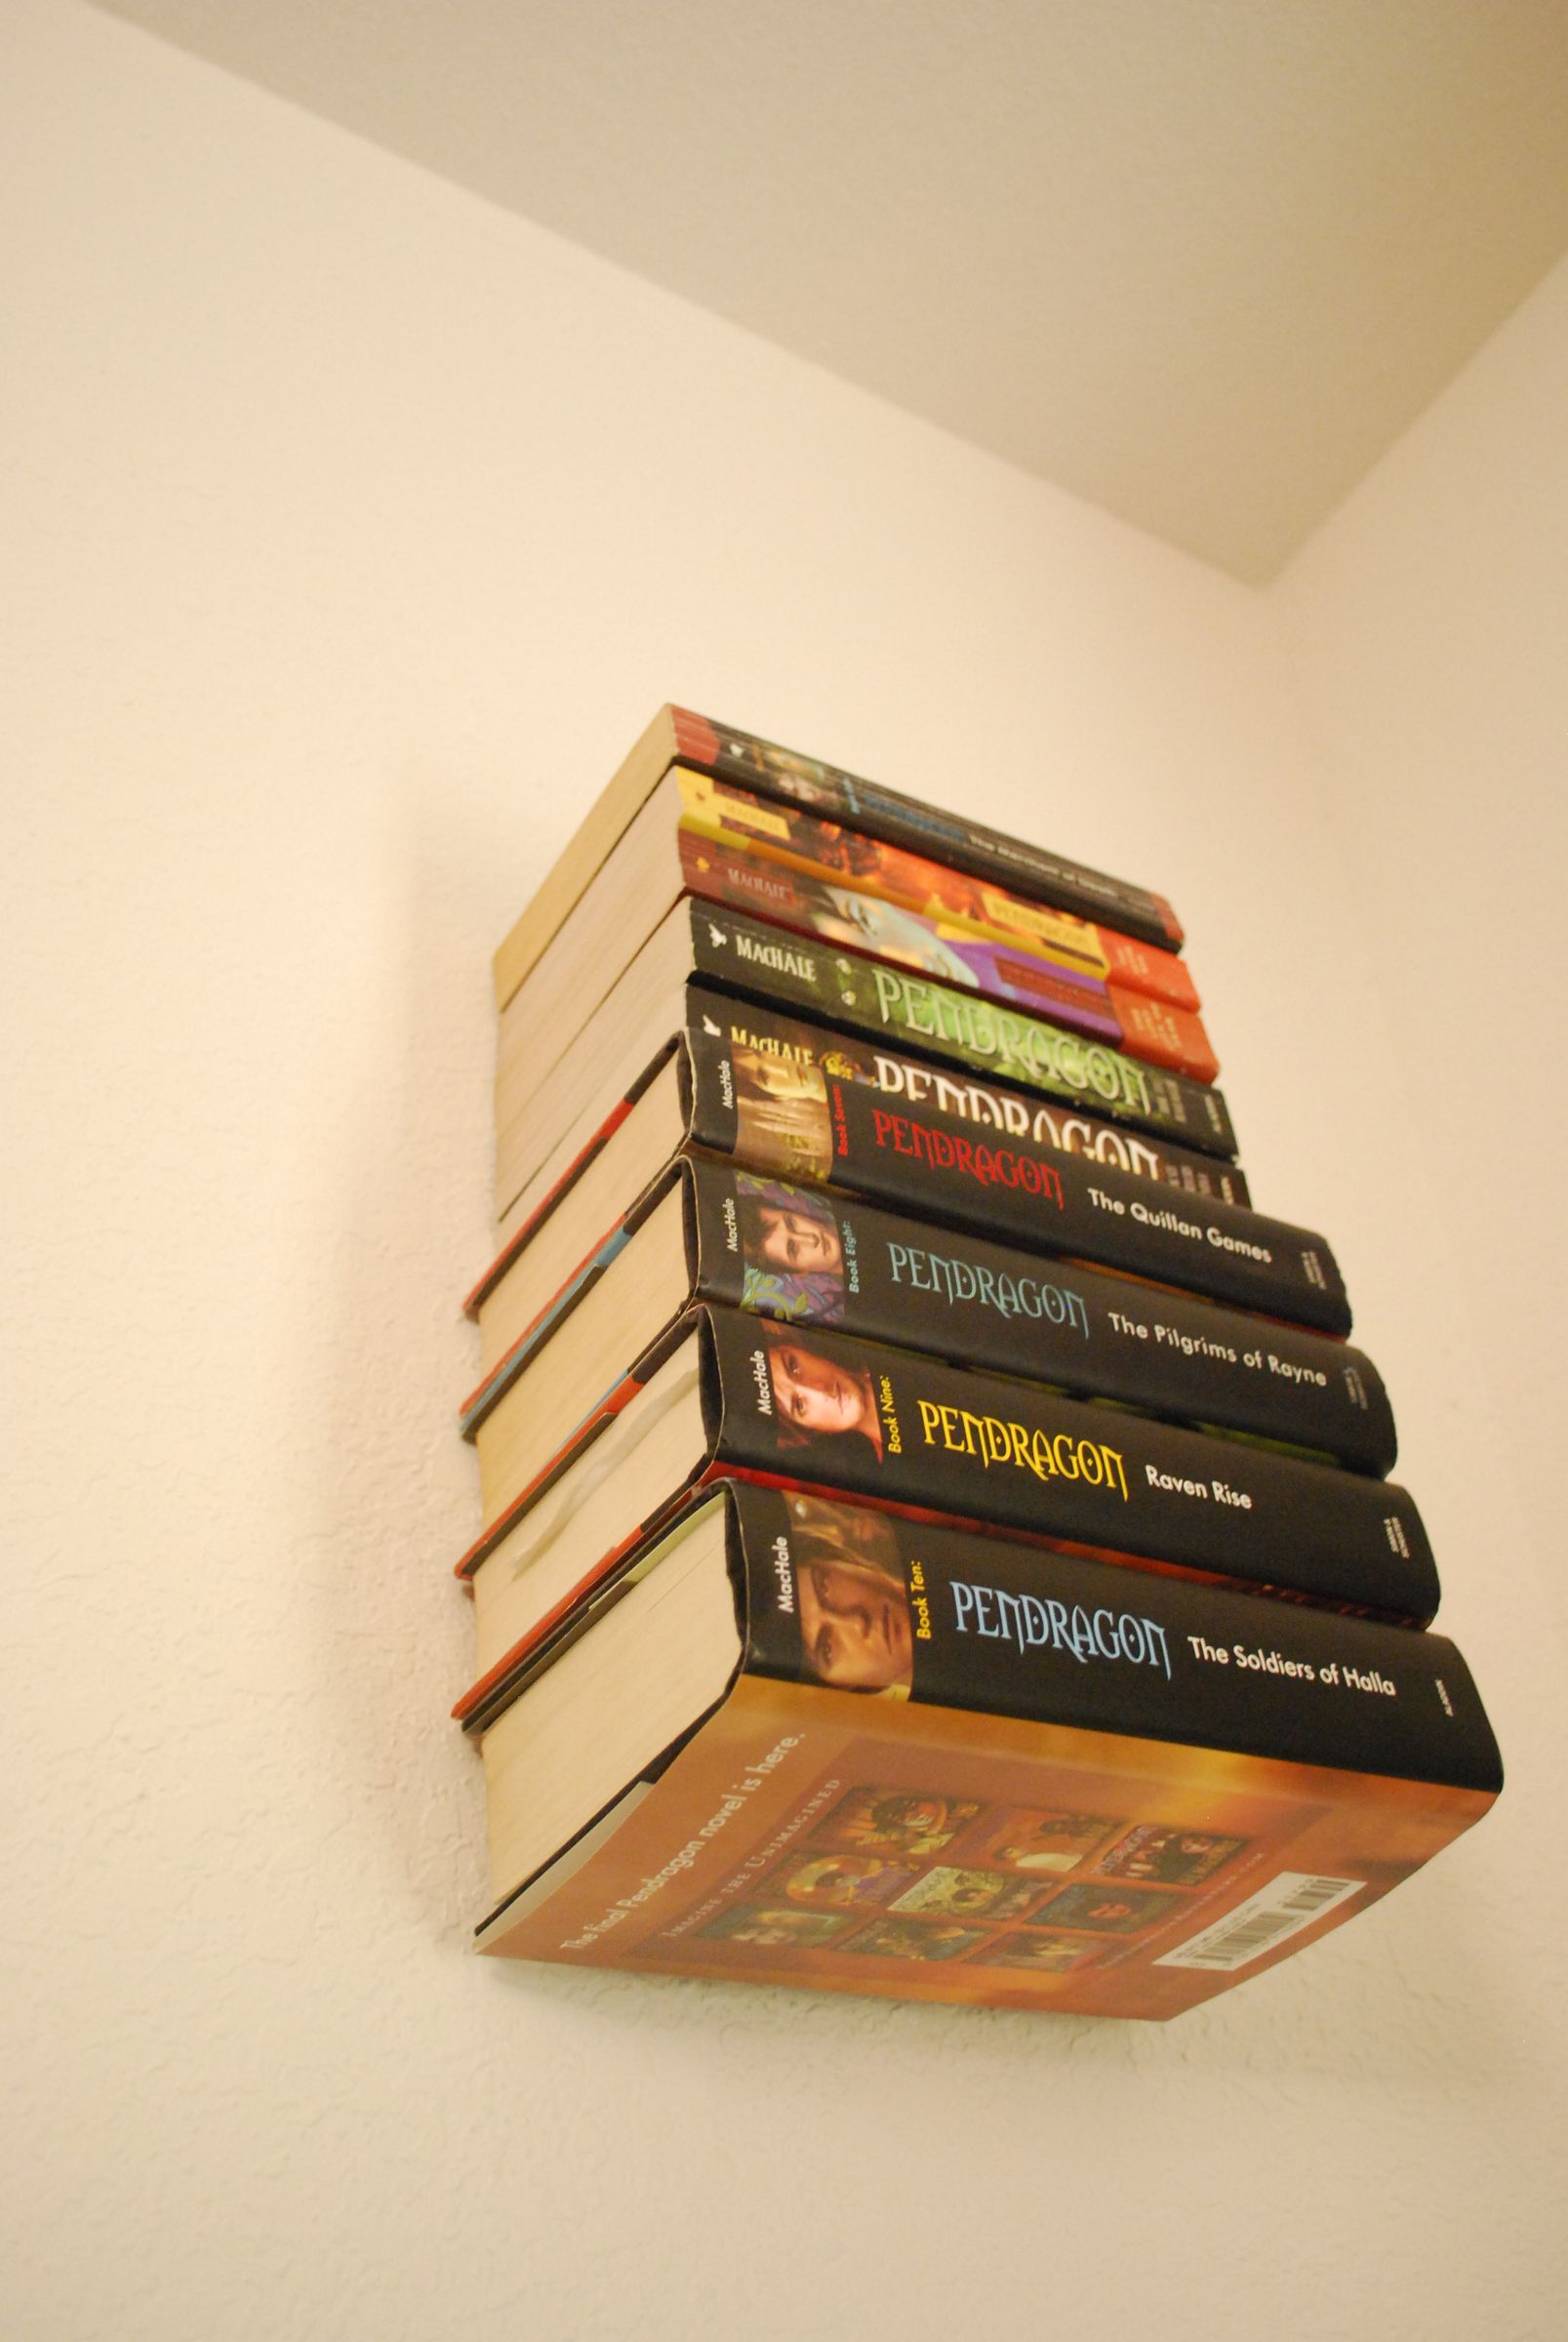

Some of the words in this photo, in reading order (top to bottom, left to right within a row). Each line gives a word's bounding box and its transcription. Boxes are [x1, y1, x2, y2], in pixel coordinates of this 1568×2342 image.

[736, 935, 816, 983] MACHALE
[872, 968, 1152, 1116] PENDRAGON
[718, 1060, 734, 1110] MacHale
[872, 1108, 1065, 1211] PENDRAGON
[722, 1197, 738, 1253] MacHale
[1087, 1188, 1126, 1216] The
[1130, 1202, 1203, 1240] Quillan
[1207, 1228, 1272, 1264] Games
[847, 1259, 860, 1294] Book
[886, 1241, 1089, 1340] PENDRAGON
[1107, 1312, 1149, 1340] The
[1154, 1324, 1237, 1364] Pilgrims
[1243, 1350, 1263, 1367] of
[1267, 1354, 1328, 1387] Rayne
[749, 1350, 773, 1416] MacHale
[883, 1416, 902, 1454] Book
[917, 1399, 1129, 1503] PENDRAGON
[1145, 1464, 1208, 1500] Raven
[1211, 1480, 1253, 1510] Rise
[771, 1536, 794, 1614] MacHale
[909, 1560, 925, 1593] Ten:
[911, 1596, 932, 1641] Book
[949, 1581, 1172, 1682] PENDRAGON
[1186, 1635, 1229, 1665] The
[1232, 1644, 1315, 1681] Soldiers
[1319, 1663, 1340, 1685] of
[1343, 1666, 1397, 1696] Halla
[745, 1732, 807, 1775] here.
[733, 1777, 762, 1793] is
[700, 1794, 747, 1838] novel
[616, 1839, 705, 1908] Pendragon
[559, 1933, 598, 1950] The
[583, 1907, 629, 1932] final
